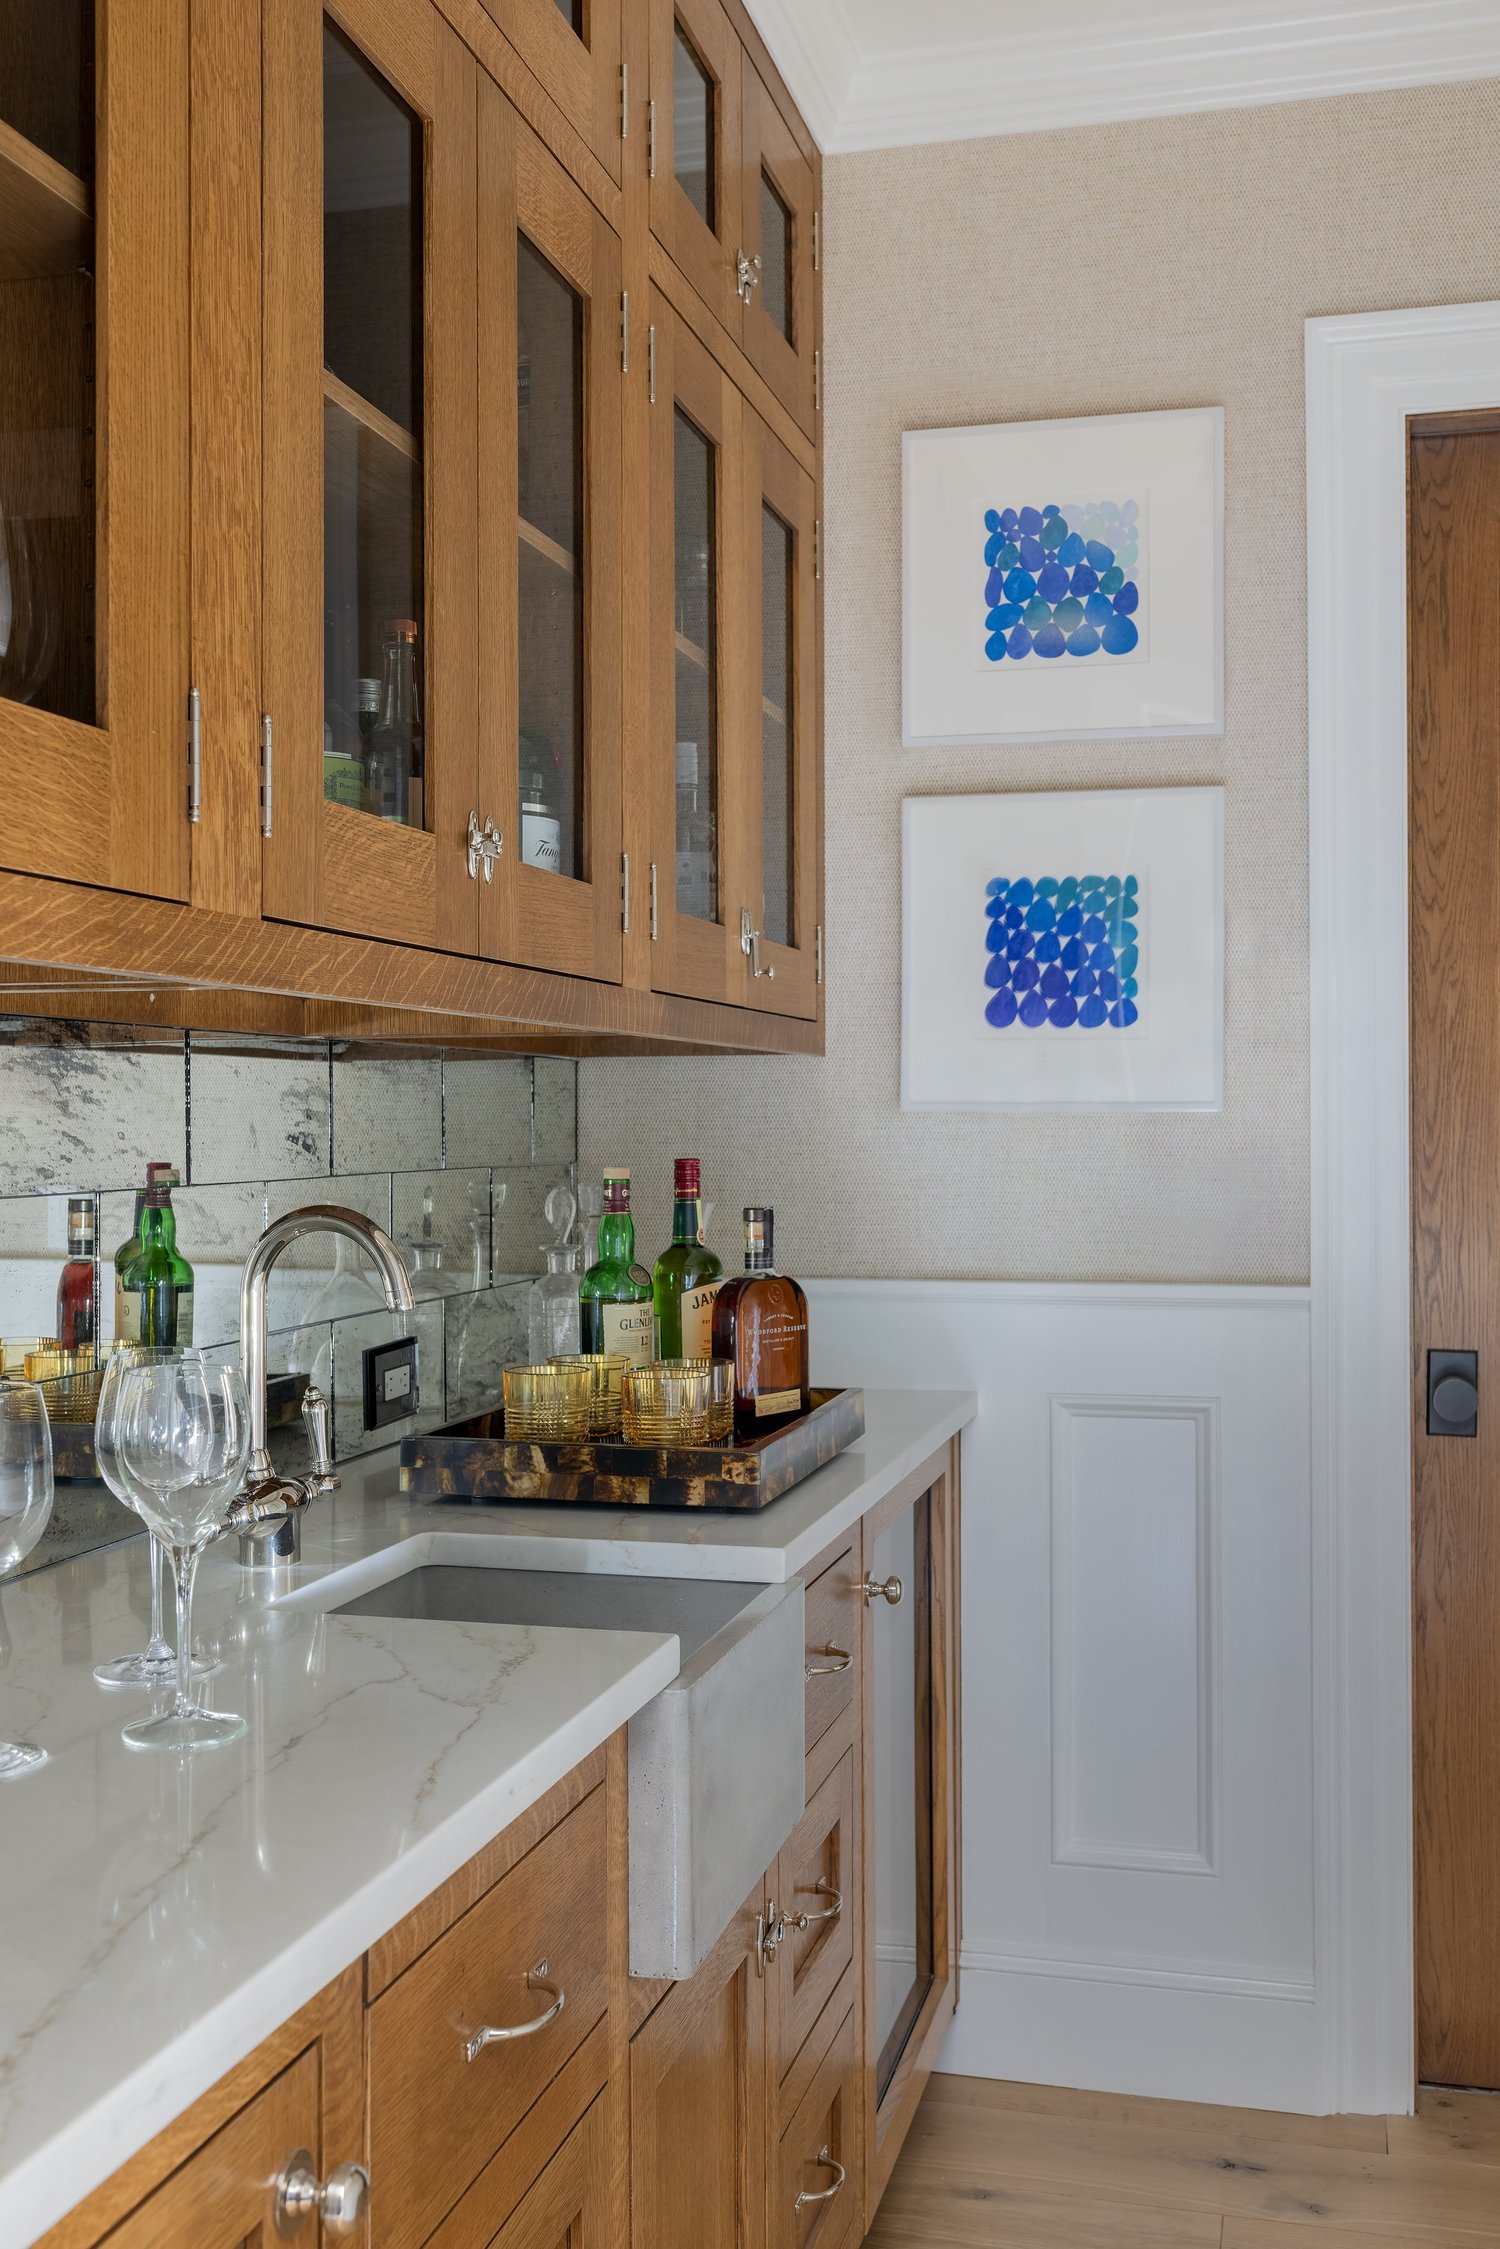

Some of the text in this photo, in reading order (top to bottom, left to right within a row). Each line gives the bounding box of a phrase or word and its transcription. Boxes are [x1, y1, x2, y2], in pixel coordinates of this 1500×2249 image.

[639, 1308, 650, 1317] THE
[783, 1324, 806, 1332] RESERVE
[640, 1335, 649, 1346] 12
